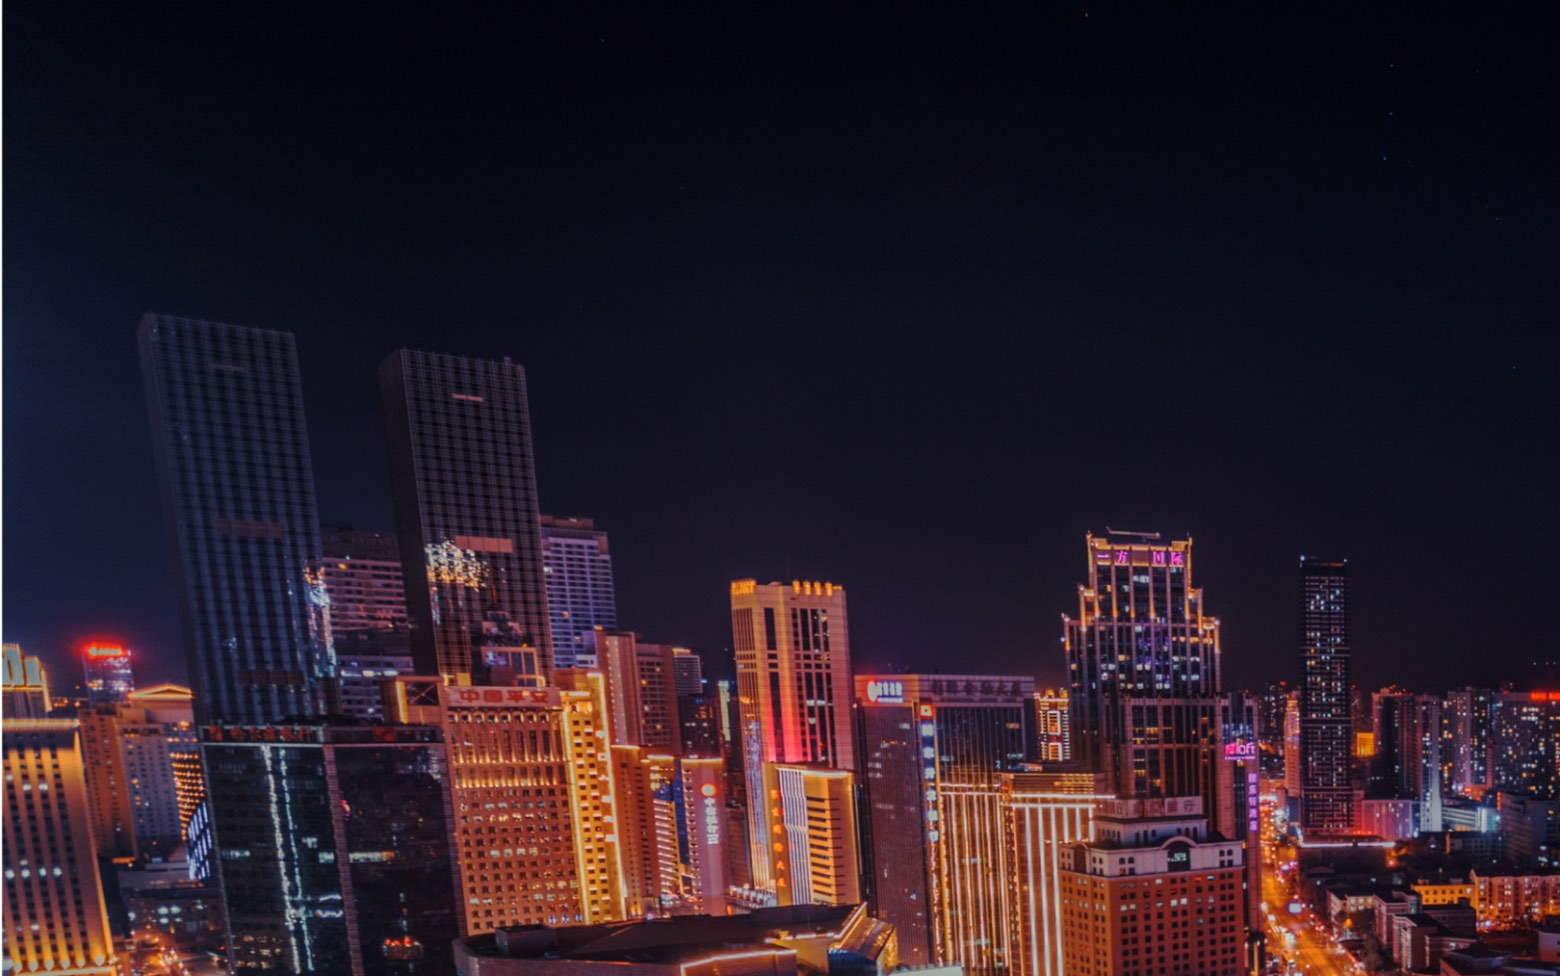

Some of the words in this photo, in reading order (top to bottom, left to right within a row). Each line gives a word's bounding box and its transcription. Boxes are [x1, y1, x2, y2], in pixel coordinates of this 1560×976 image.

[460, 689, 549, 703] 中国平安
[1224, 739, 1256, 755] aloft
